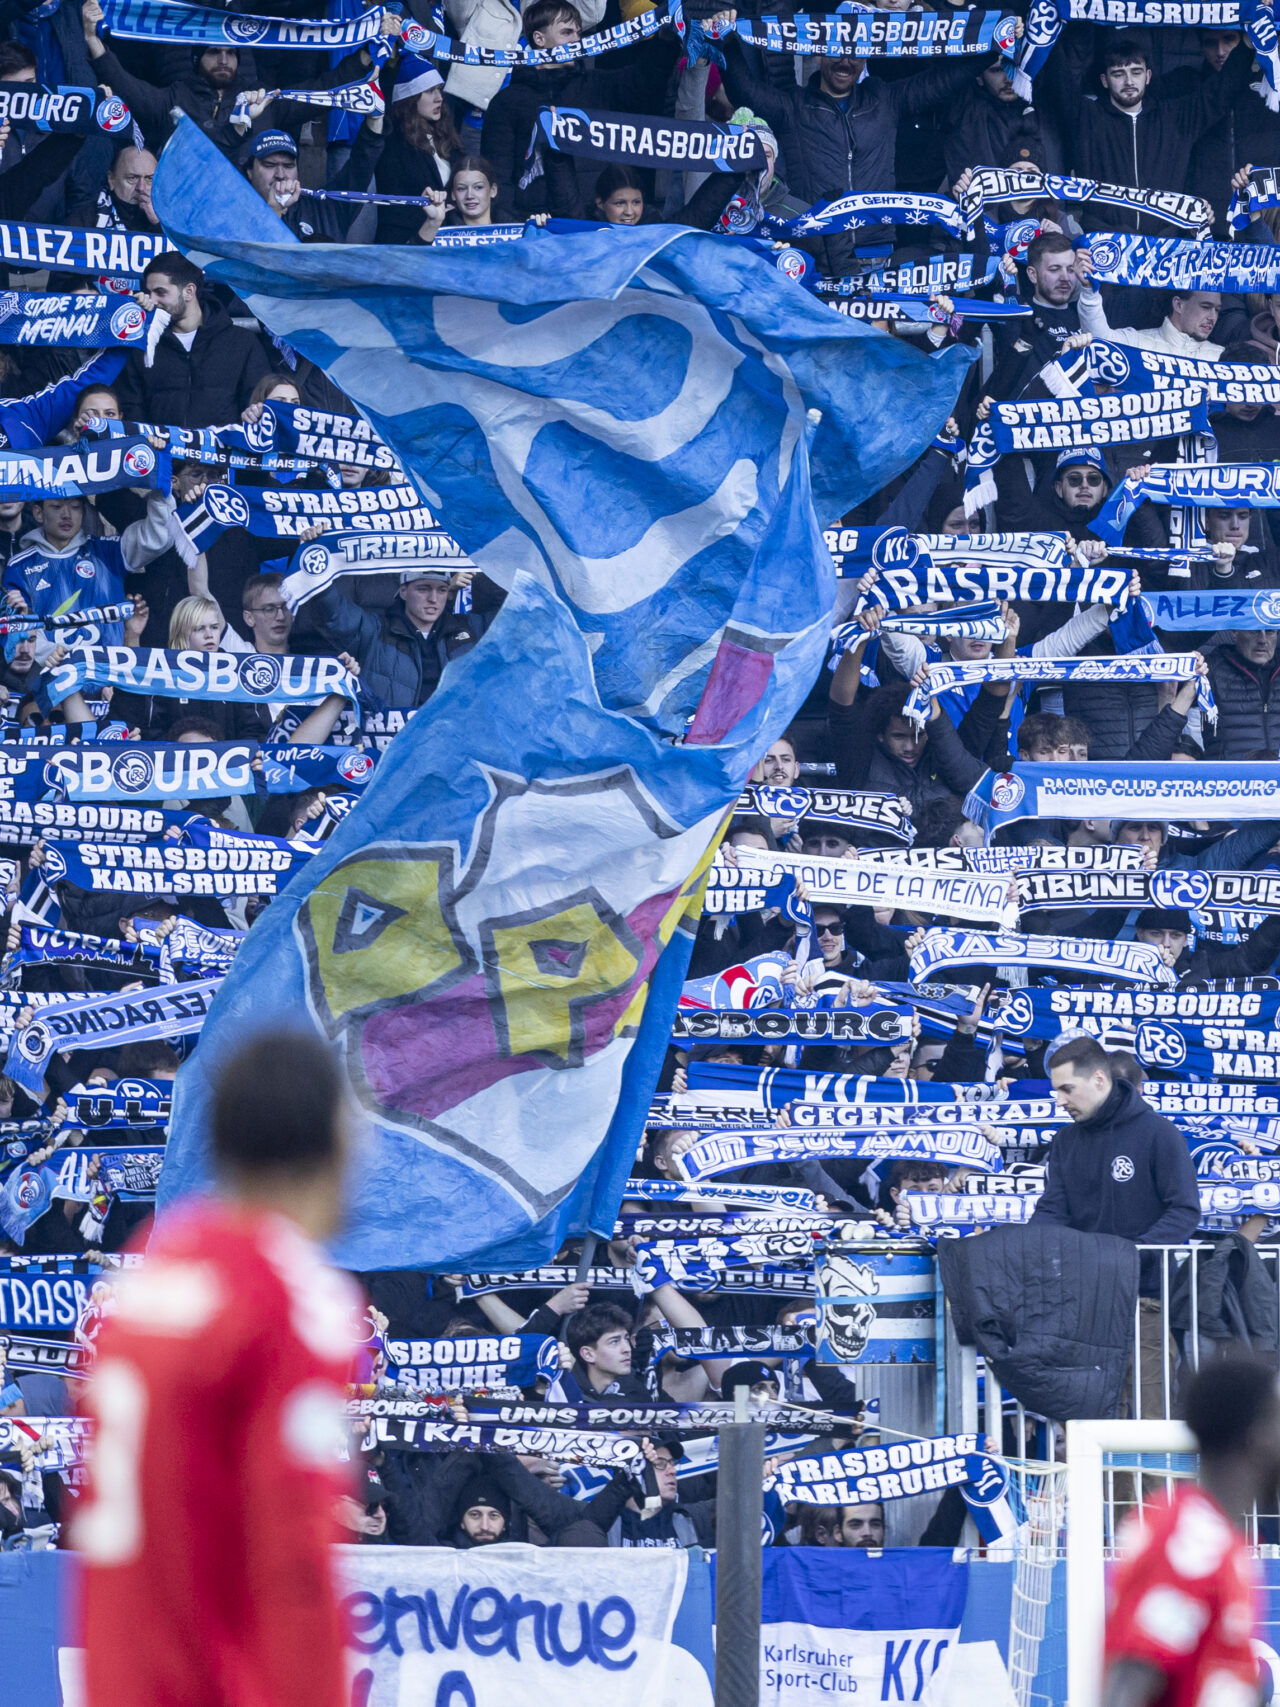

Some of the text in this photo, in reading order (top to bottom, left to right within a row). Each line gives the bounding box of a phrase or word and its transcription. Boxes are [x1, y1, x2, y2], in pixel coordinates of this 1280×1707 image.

[1069, 2, 1240, 26] KARLSRUHE
[465, 8, 656, 60] RC STRASBOURG
[766, 18, 965, 46] RC STRASBOURG
[771, 42, 786, 52] NE
[787, 43, 829, 55] SOMMES
[831, 46, 853, 56] PAS
[921, 45, 942, 56] DES
[945, 42, 989, 55] MILLIERS
[551, 114, 756, 160] RC STRASBOURG
[918, 198, 944, 211] LOS
[25, 296, 69, 315] STADE
[19, 313, 98, 344] MEINAU
[1000, 386, 1203, 426] STRASBOURG
[1011, 411, 1191, 450] KARLSRUHE
[204, 451, 226, 464] PAS
[1177, 466, 1270, 493] MUR
[1156, 595, 1248, 619] ALLEZ
[1041, 777, 1278, 798] RACING CLUB STRASBOURG
[79, 841, 293, 874] STRASBOURG
[90, 868, 277, 895] KARLSRUHE
[857, 872, 884, 894] DE
[893, 873, 923, 897] LA
[1050, 989, 1263, 1018] STRASBOURG
[1163, 1082, 1258, 1098] CLUB DE
[499, 1405, 679, 1425] UNIS POUR
[776, 1457, 968, 1507] KARLSRUHE
[763, 1643, 855, 1668] Karlsruher
[765, 1668, 859, 1695] Sport-Club
